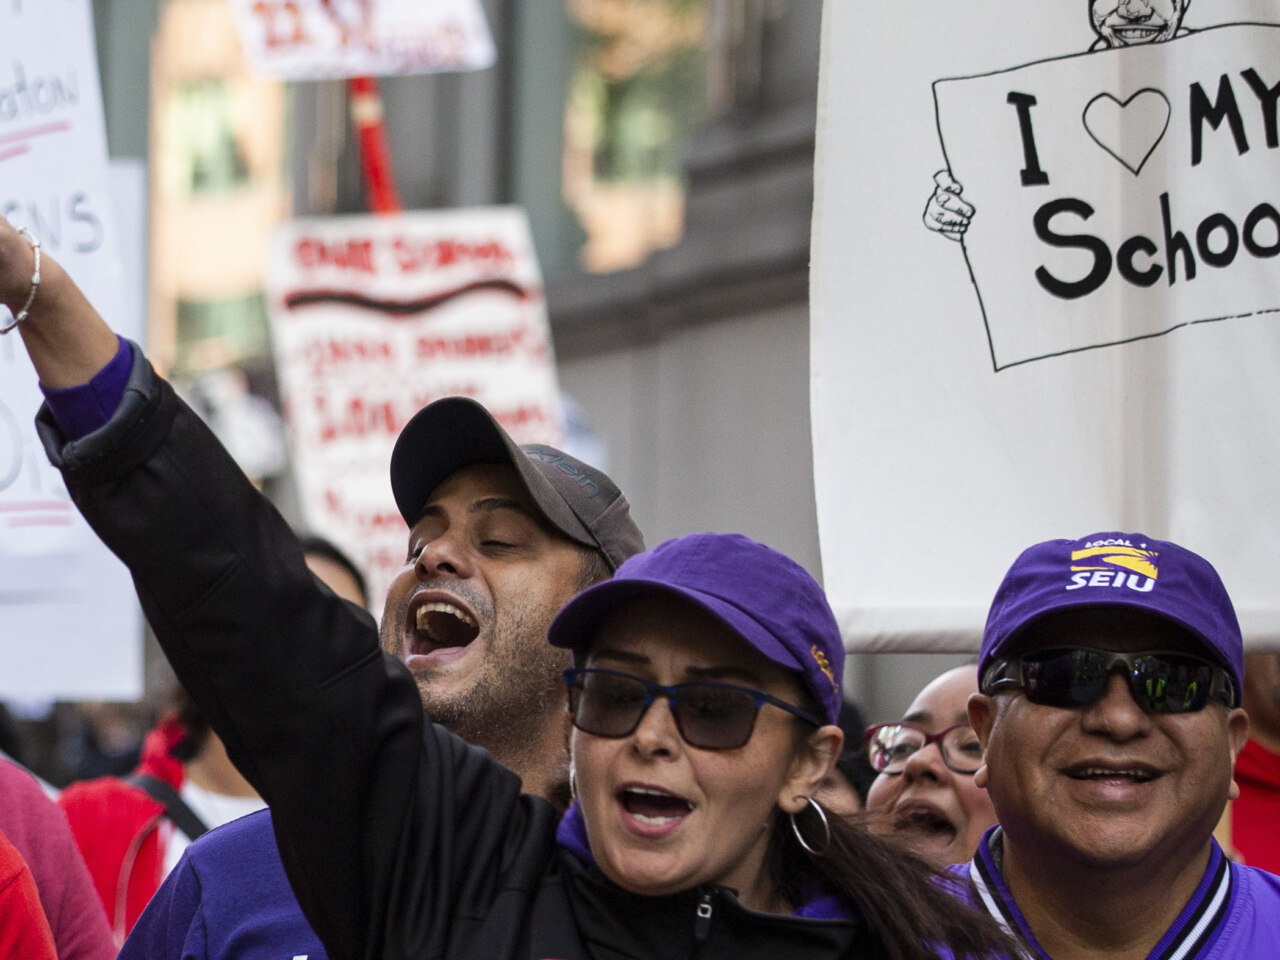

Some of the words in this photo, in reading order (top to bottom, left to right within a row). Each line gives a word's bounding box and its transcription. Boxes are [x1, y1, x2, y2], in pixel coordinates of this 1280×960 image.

[1007, 91, 1050, 187] I
[1190, 67, 1280, 167] MY
[1033, 192, 1280, 301] Schoo
[1084, 538, 1134, 549] LOCAL
[1065, 570, 1156, 592] SEIU
